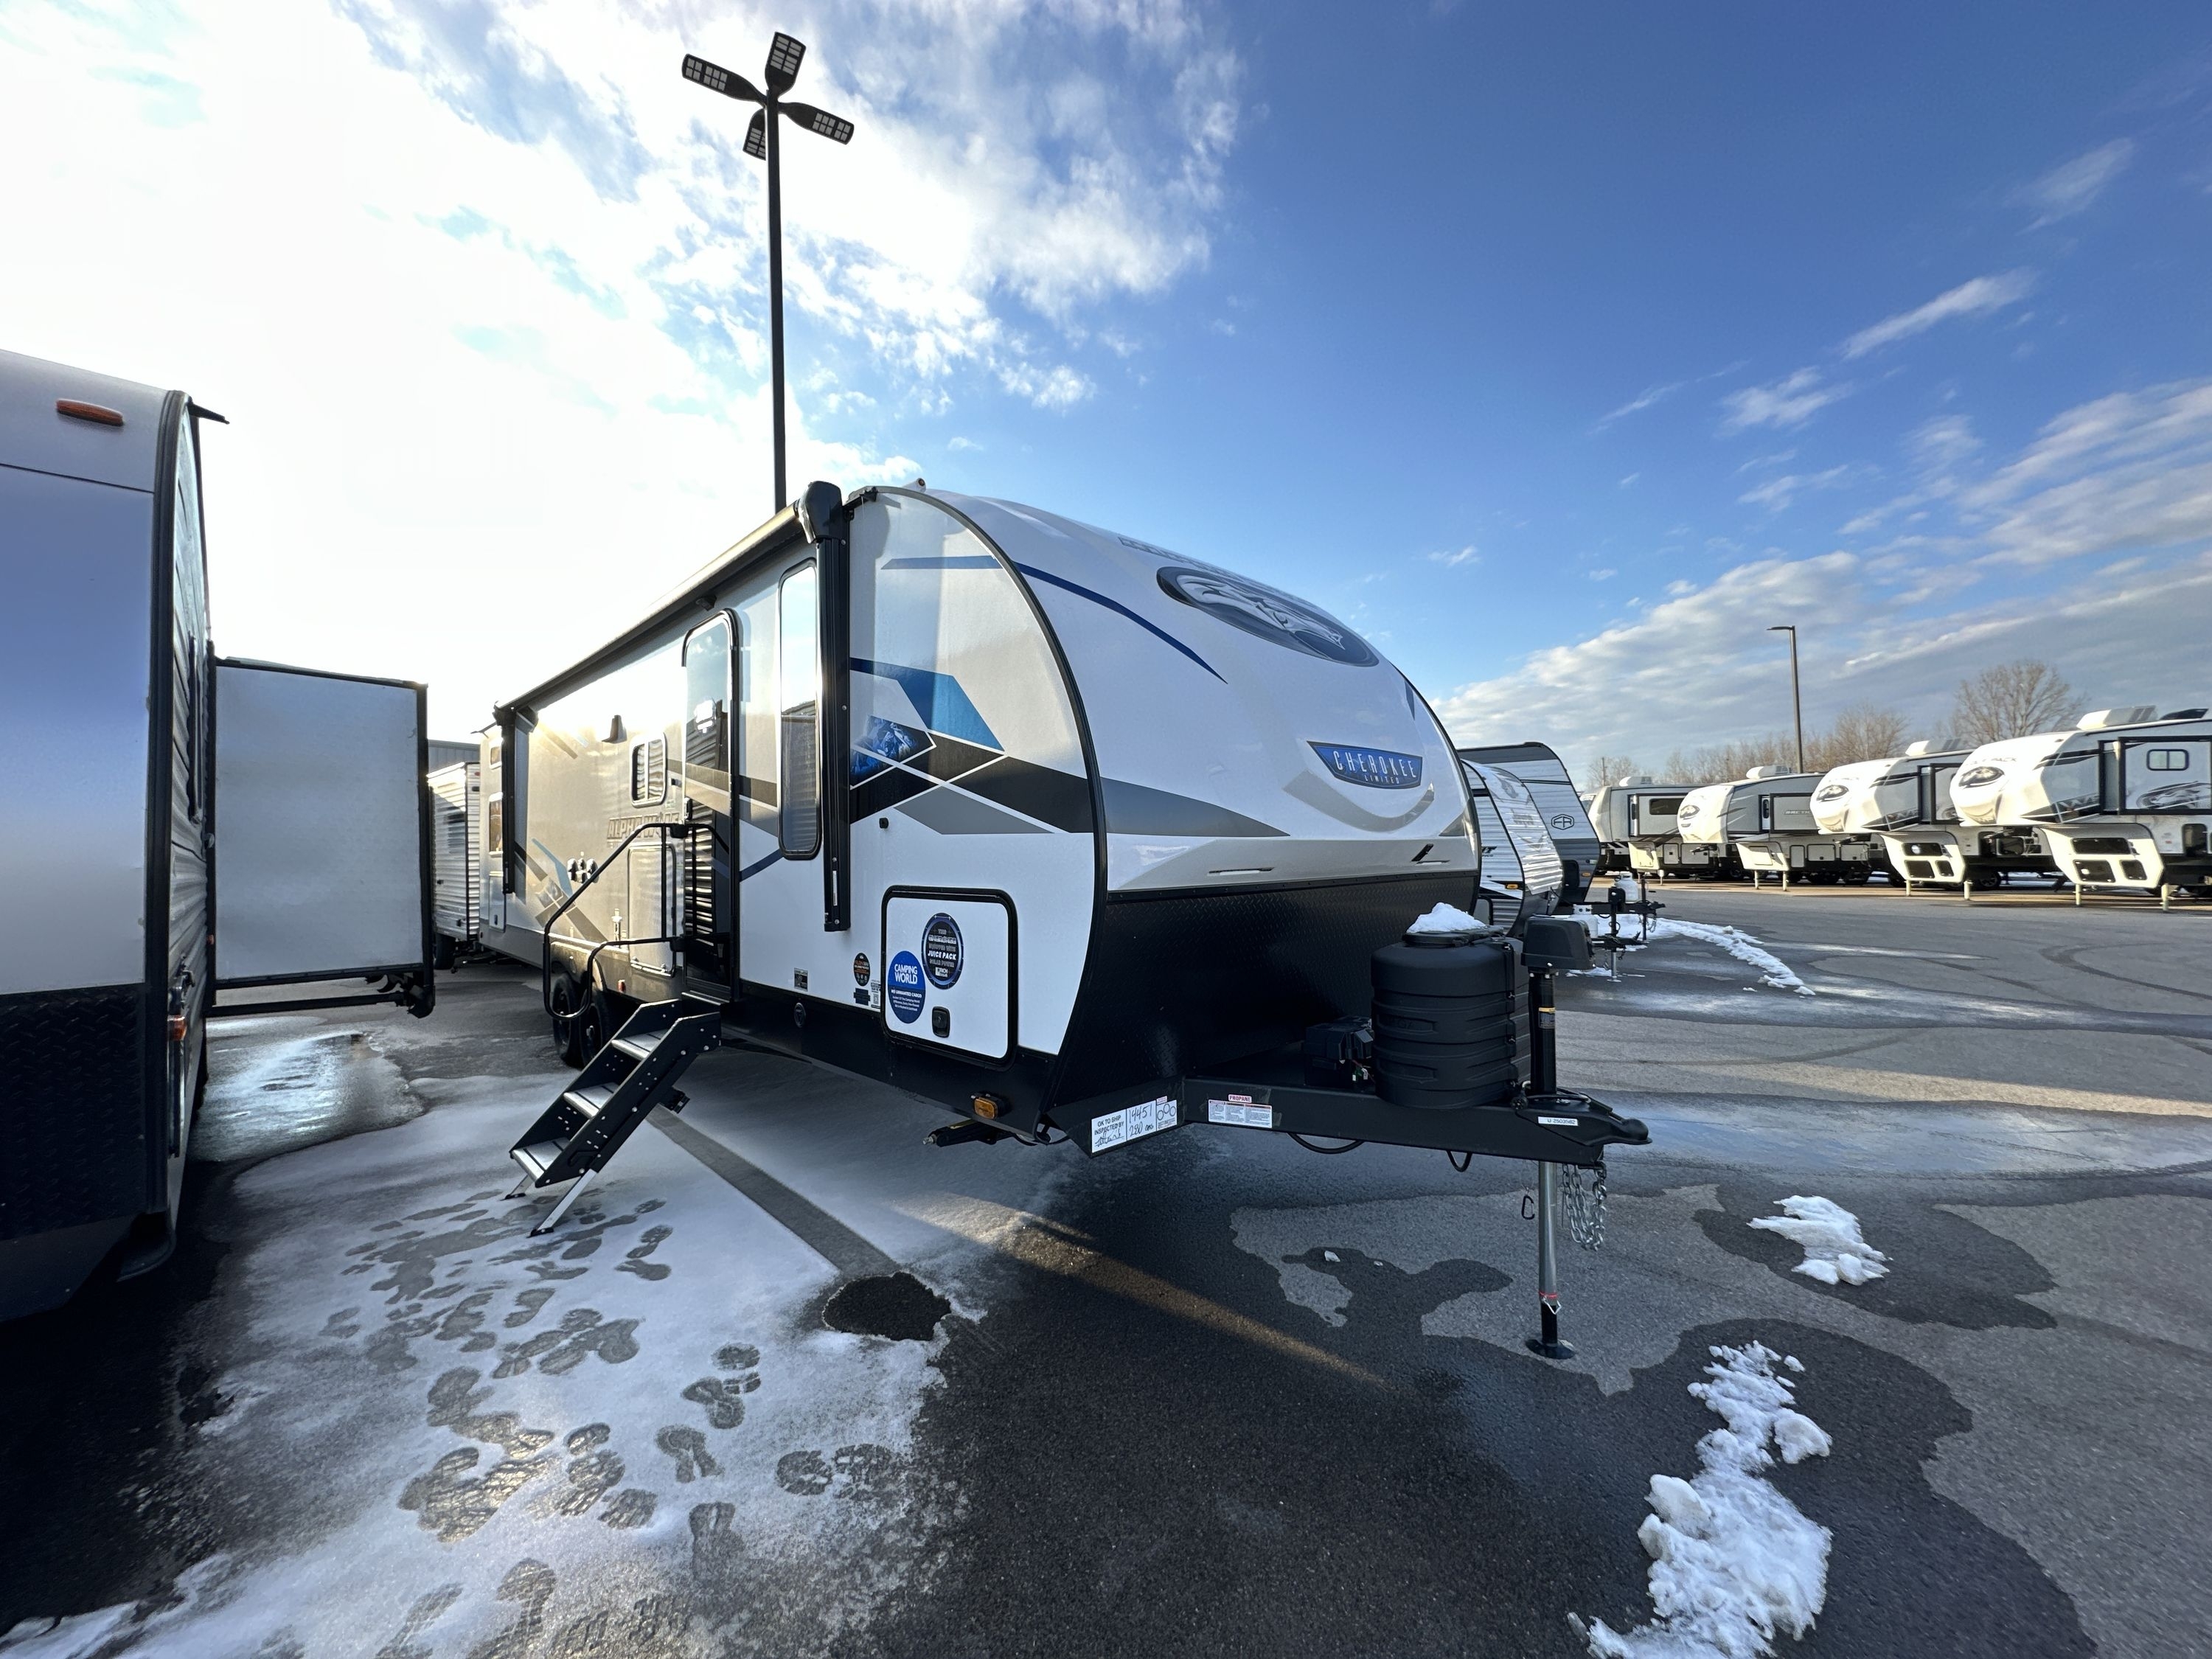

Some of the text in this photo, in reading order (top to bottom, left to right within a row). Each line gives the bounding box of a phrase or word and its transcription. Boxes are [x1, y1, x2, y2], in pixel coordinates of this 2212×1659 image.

[1333, 751, 1416, 778] CHEROKEE
[1364, 774, 1399, 785] LIMITED
[928, 950, 957, 961] JUICE PACK
[894, 964, 918, 975] CAMPING
[894, 972, 918, 985] WORLD
[1111, 1114, 1121, 1122] SHIP
[1094, 1123, 1118, 1135] INSPECTED
